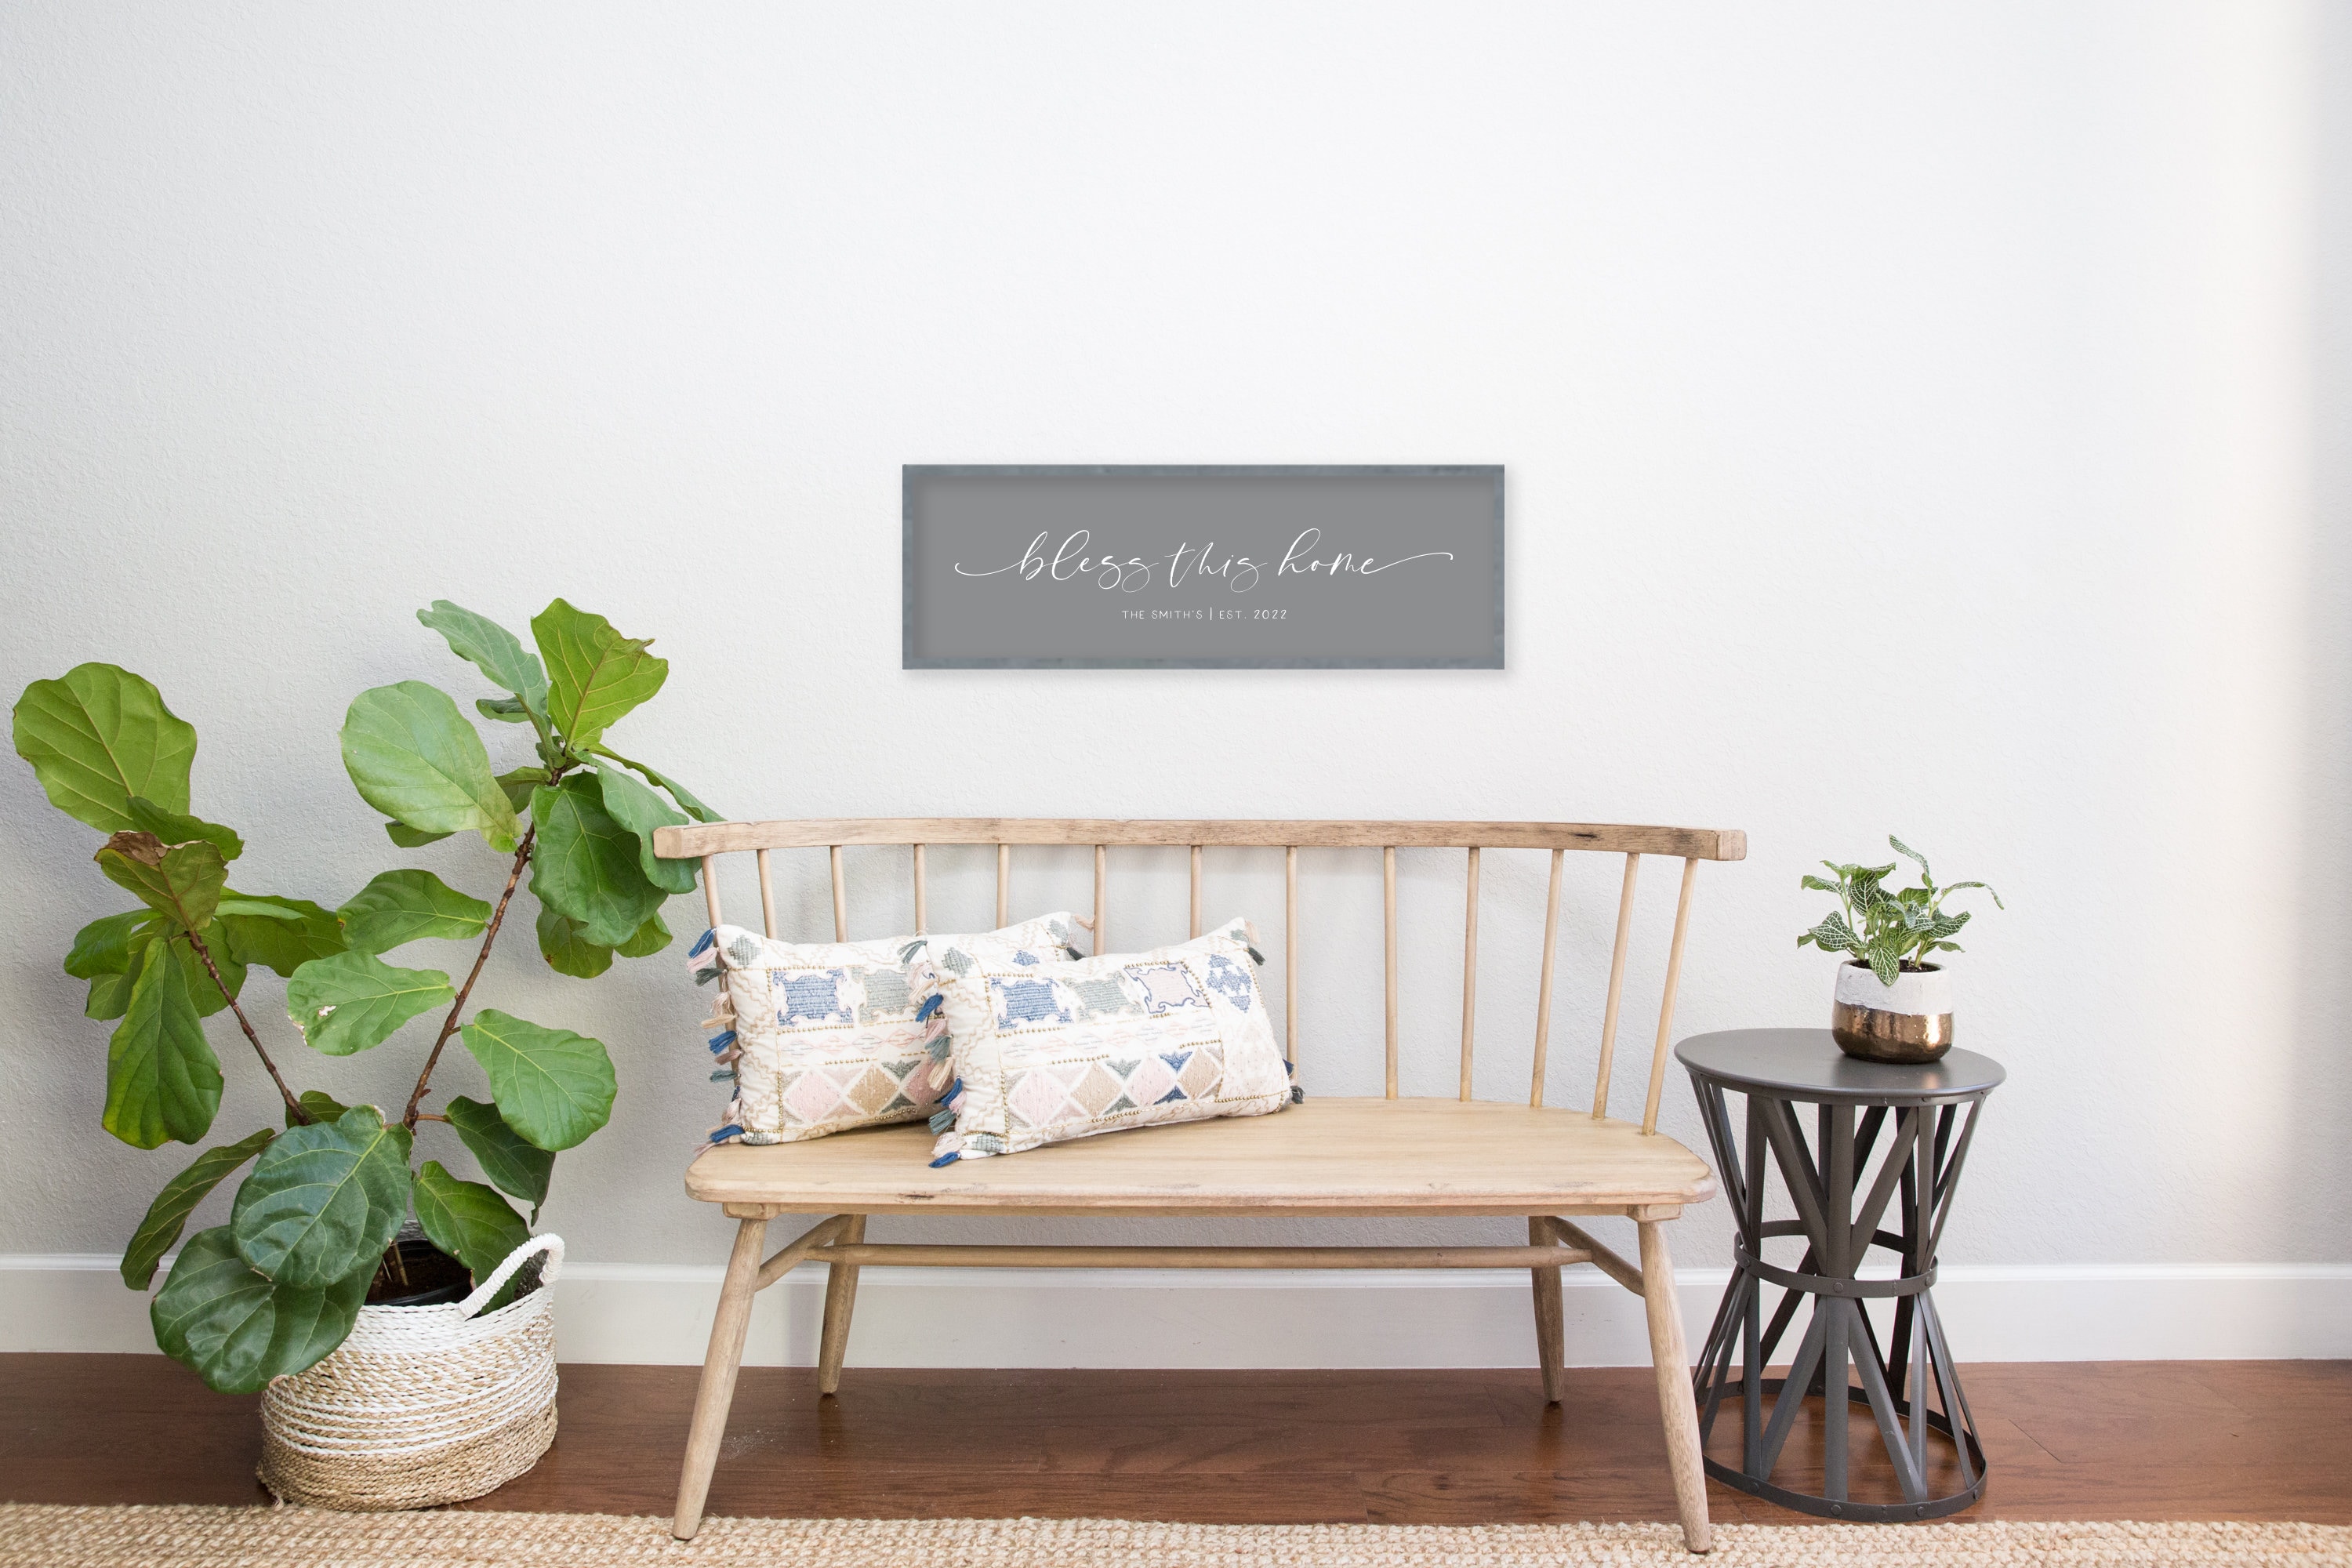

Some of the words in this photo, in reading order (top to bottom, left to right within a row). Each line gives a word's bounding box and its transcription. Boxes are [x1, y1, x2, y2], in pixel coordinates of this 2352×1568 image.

[954, 529, 1160, 593] bless
[1163, 541, 1268, 593] this
[1277, 528, 1454, 577] home
[1121, 609, 1145, 620] THE
[1151, 609, 1203, 620] SMITH'S
[1218, 609, 1247, 620] EST.
[1253, 609, 1287, 620] 2022
